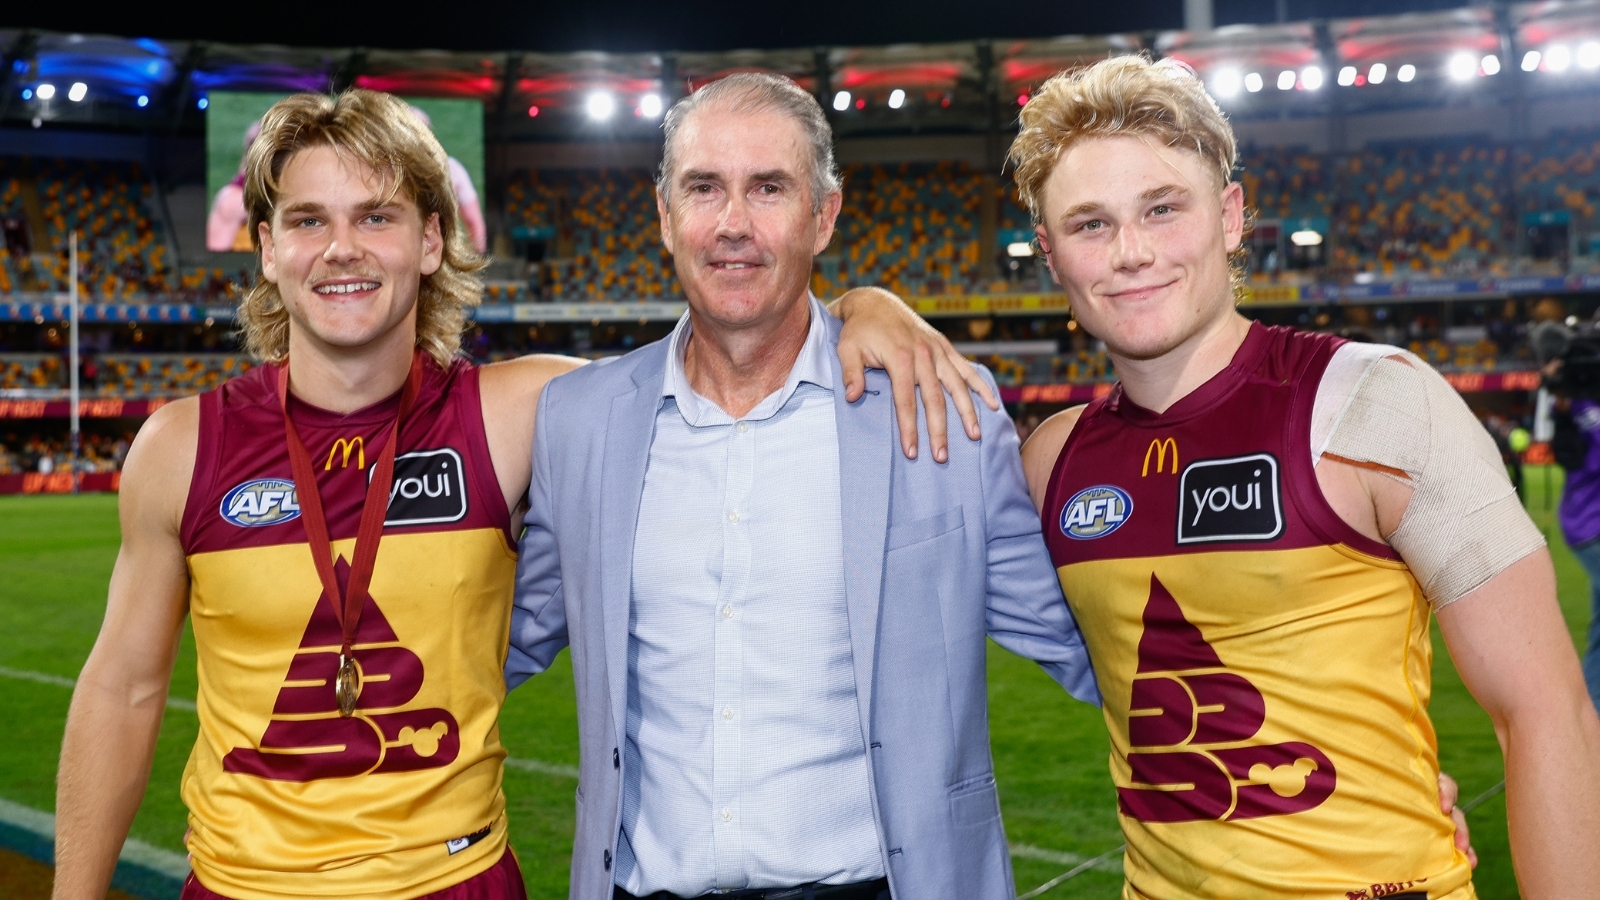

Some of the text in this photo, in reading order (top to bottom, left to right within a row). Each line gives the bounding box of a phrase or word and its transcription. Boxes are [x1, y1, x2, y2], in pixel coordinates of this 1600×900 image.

[227, 491, 301, 517] AFL
[1063, 497, 1124, 529] AFL
[1192, 468, 1261, 527] youi
